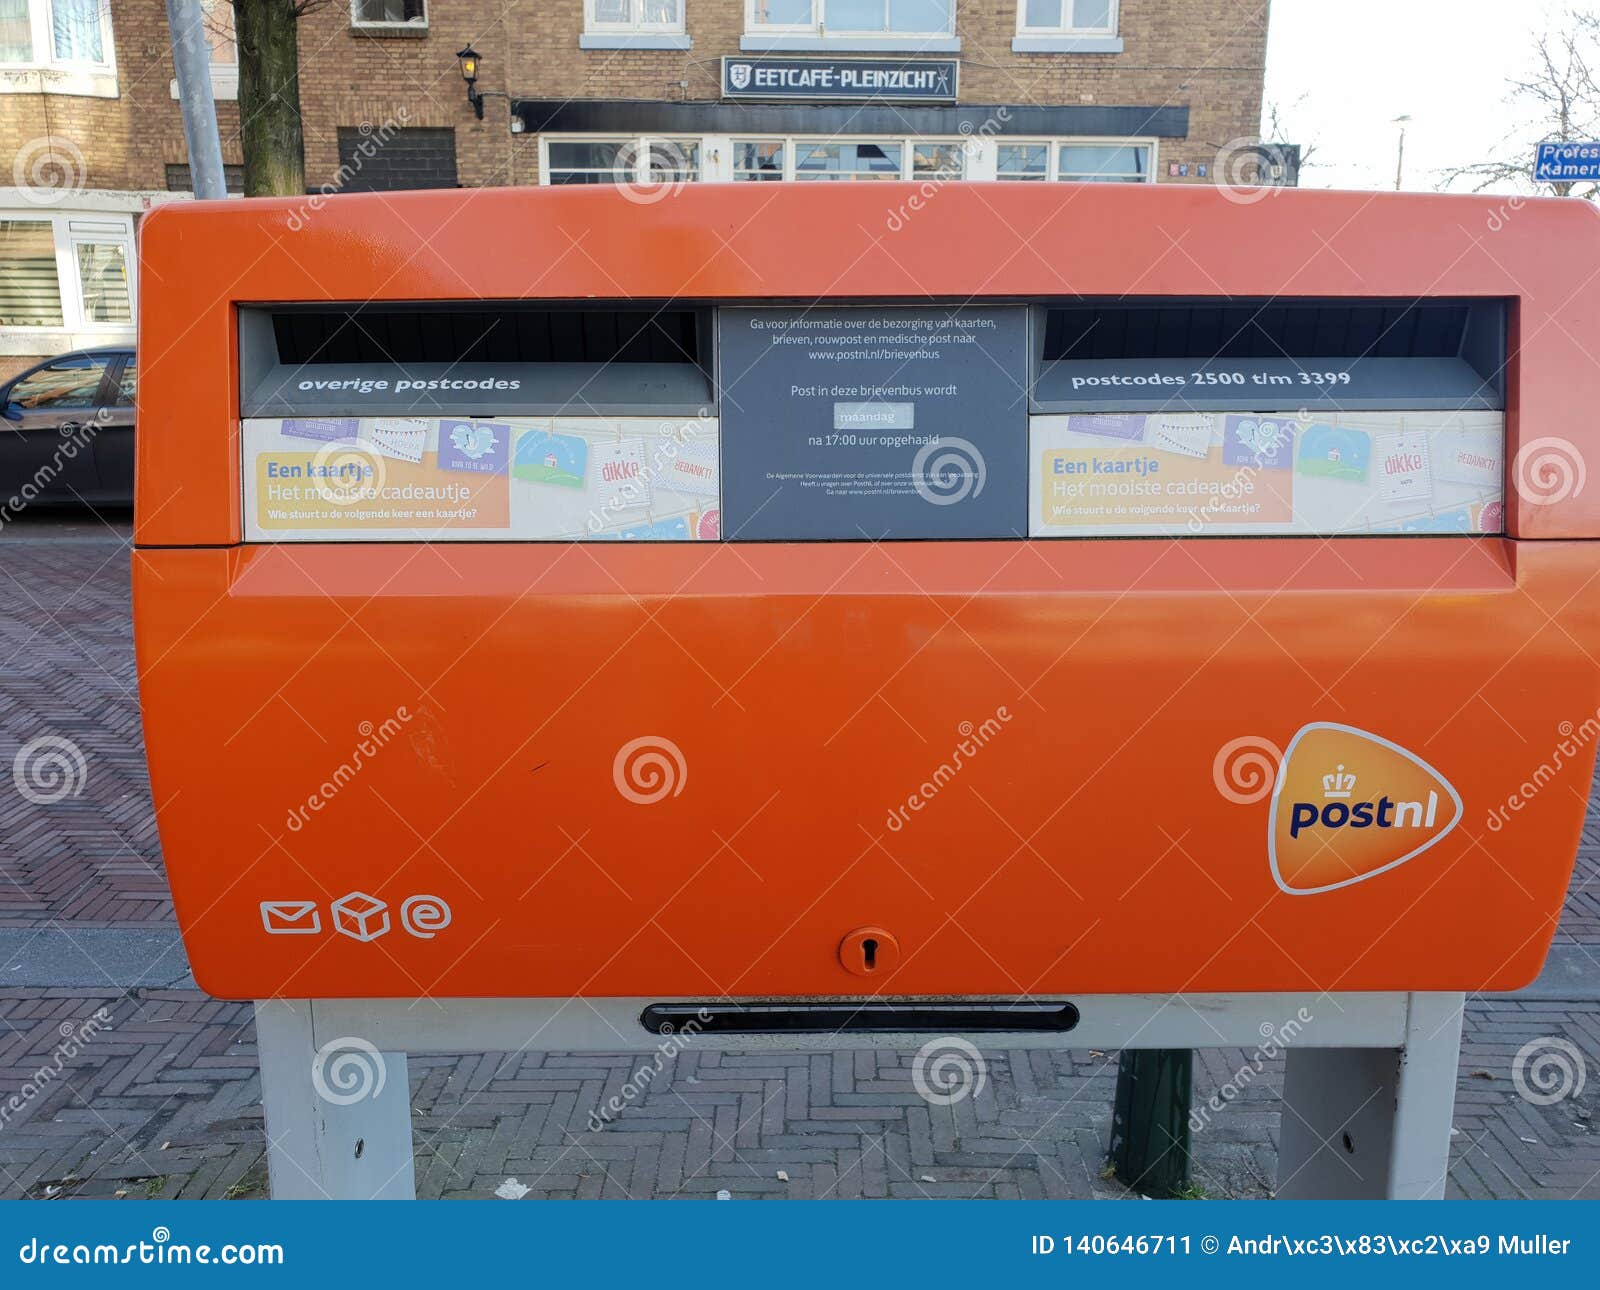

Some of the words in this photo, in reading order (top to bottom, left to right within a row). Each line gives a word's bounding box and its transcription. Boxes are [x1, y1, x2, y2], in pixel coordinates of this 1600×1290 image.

[750, 320, 764, 329] Ga
[766, 321, 789, 329] voor
[789, 318, 843, 329] informatie
[844, 321, 867, 329] over
[868, 318, 881, 329] de
[883, 318, 934, 331] bezorging
[935, 320, 953, 329] van
[955, 318, 997, 330] kaarten,
[773, 334, 813, 346] brieven,
[814, 335, 862, 346] rouwpost
[864, 336, 877, 344] en
[878, 334, 929, 344] medische
[929, 335, 952, 346] post
[953, 336, 976, 344] naar
[808, 349, 940, 362] www.postnl.nl/brievenbus
[298, 377, 388, 394] overige
[395, 377, 521, 394] postcodes
[1071, 373, 1186, 390] postcodes
[1191, 373, 1245, 385] 2500
[1252, 373, 1293, 385] t/m
[1299, 373, 1351, 385] 3399
[791, 385, 817, 397] Post
[818, 385, 829, 397] in
[830, 385, 858, 397] deze
[860, 385, 922, 397] brievenbus
[924, 385, 957, 397] wordt
[808, 437, 823, 446] na
[825, 435, 857, 446] 17:00
[858, 437, 878, 446] uur
[880, 435, 940, 448] opgehaald
[267, 462, 302, 478] Een
[306, 462, 374, 481] kaartje
[1053, 458, 1087, 474] Een
[1092, 458, 1159, 477] kaartje
[1385, 453, 1422, 475] dikke
[268, 484, 300, 500] Het
[305, 484, 377, 500] mooiste
[381, 483, 470, 503] cadeautje
[1053, 480, 1085, 497] Het
[1089, 480, 1161, 497] mooiste
[268, 509, 287, 519] Wie
[287, 509, 320, 519] stuurt
[321, 511, 328, 519] u
[330, 509, 342, 519] de
[344, 509, 389, 521] volgende
[391, 509, 414, 519] keer
[415, 511, 434, 519] een
[436, 509, 477, 521] kaartje?
[1052, 504, 1072, 515] Wie
[1072, 504, 1105, 515] stuurt
[1106, 507, 1113, 515] u
[1115, 504, 1127, 515] de
[1129, 504, 1174, 516] volgende
[1176, 504, 1198, 515] keer
[1220, 504, 1261, 516] kaartje?
[1290, 790, 1438, 840] postnl
